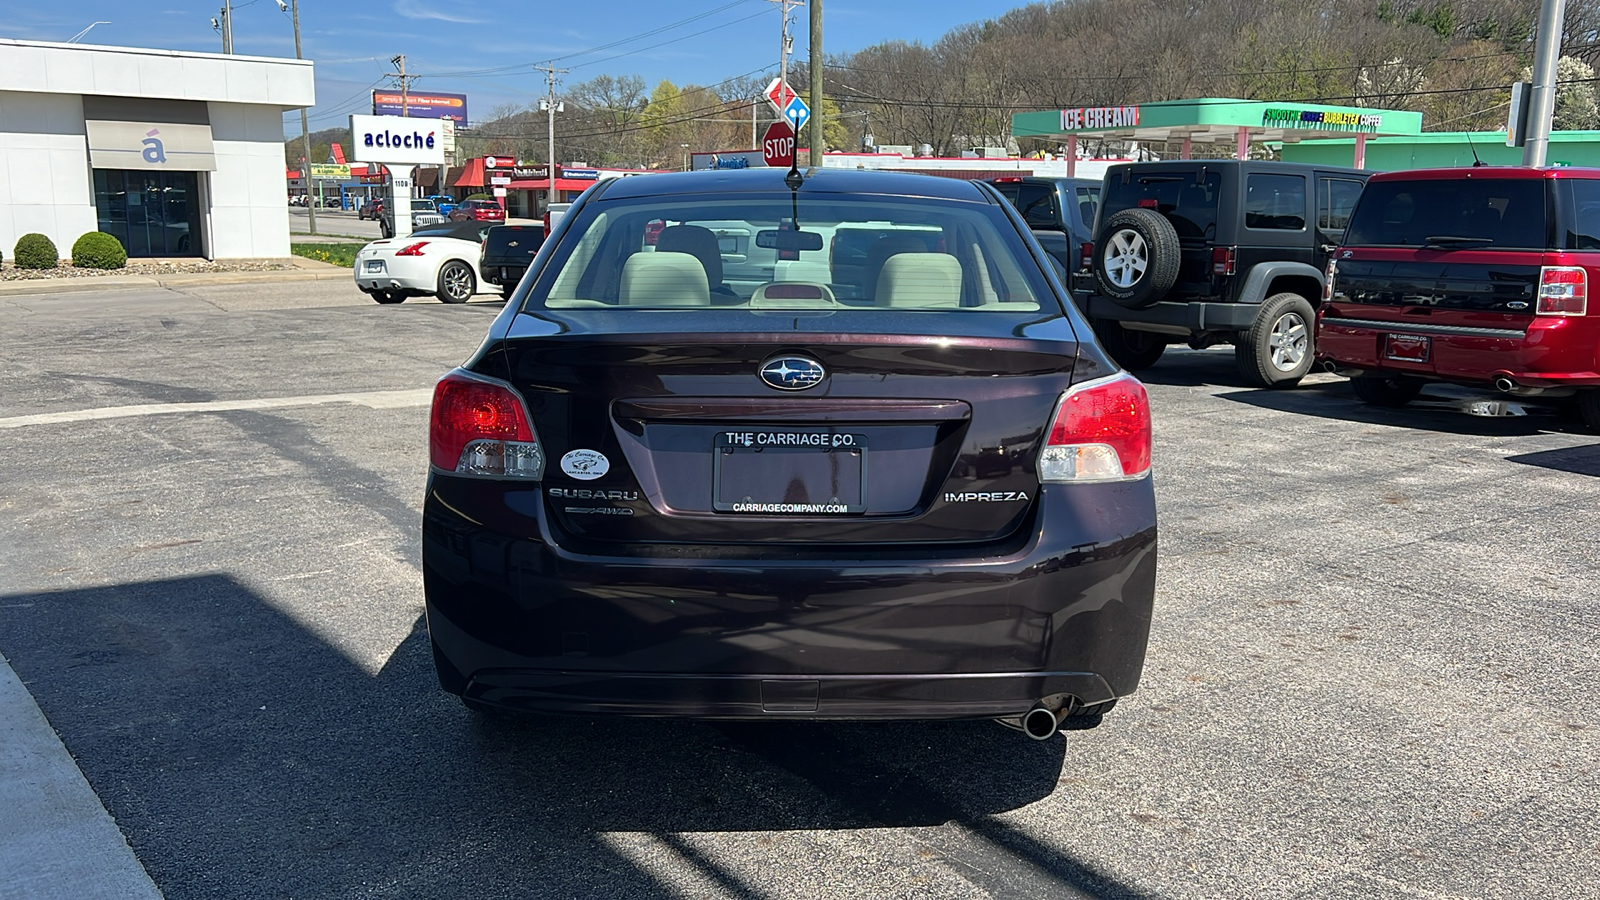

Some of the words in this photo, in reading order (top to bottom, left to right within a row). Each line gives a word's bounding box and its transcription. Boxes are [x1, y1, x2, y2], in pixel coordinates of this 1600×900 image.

[1060, 109, 1083, 130] ICE
[1085, 105, 1138, 128] CREAM
[1360, 114, 1382, 127] COFFEE
[141, 128, 167, 164] á
[364, 130, 435, 149] acloché
[765, 137, 794, 159] STOP
[726, 432, 754, 444] THE
[757, 433, 829, 446] CARRIAGE
[832, 434, 857, 447] CO.
[549, 488, 638, 501] SUBARU
[945, 491, 1029, 502] IMPREZA
[592, 507, 634, 515] AWD
[732, 503, 848, 513] CARRIAGECOMPANY.COM
